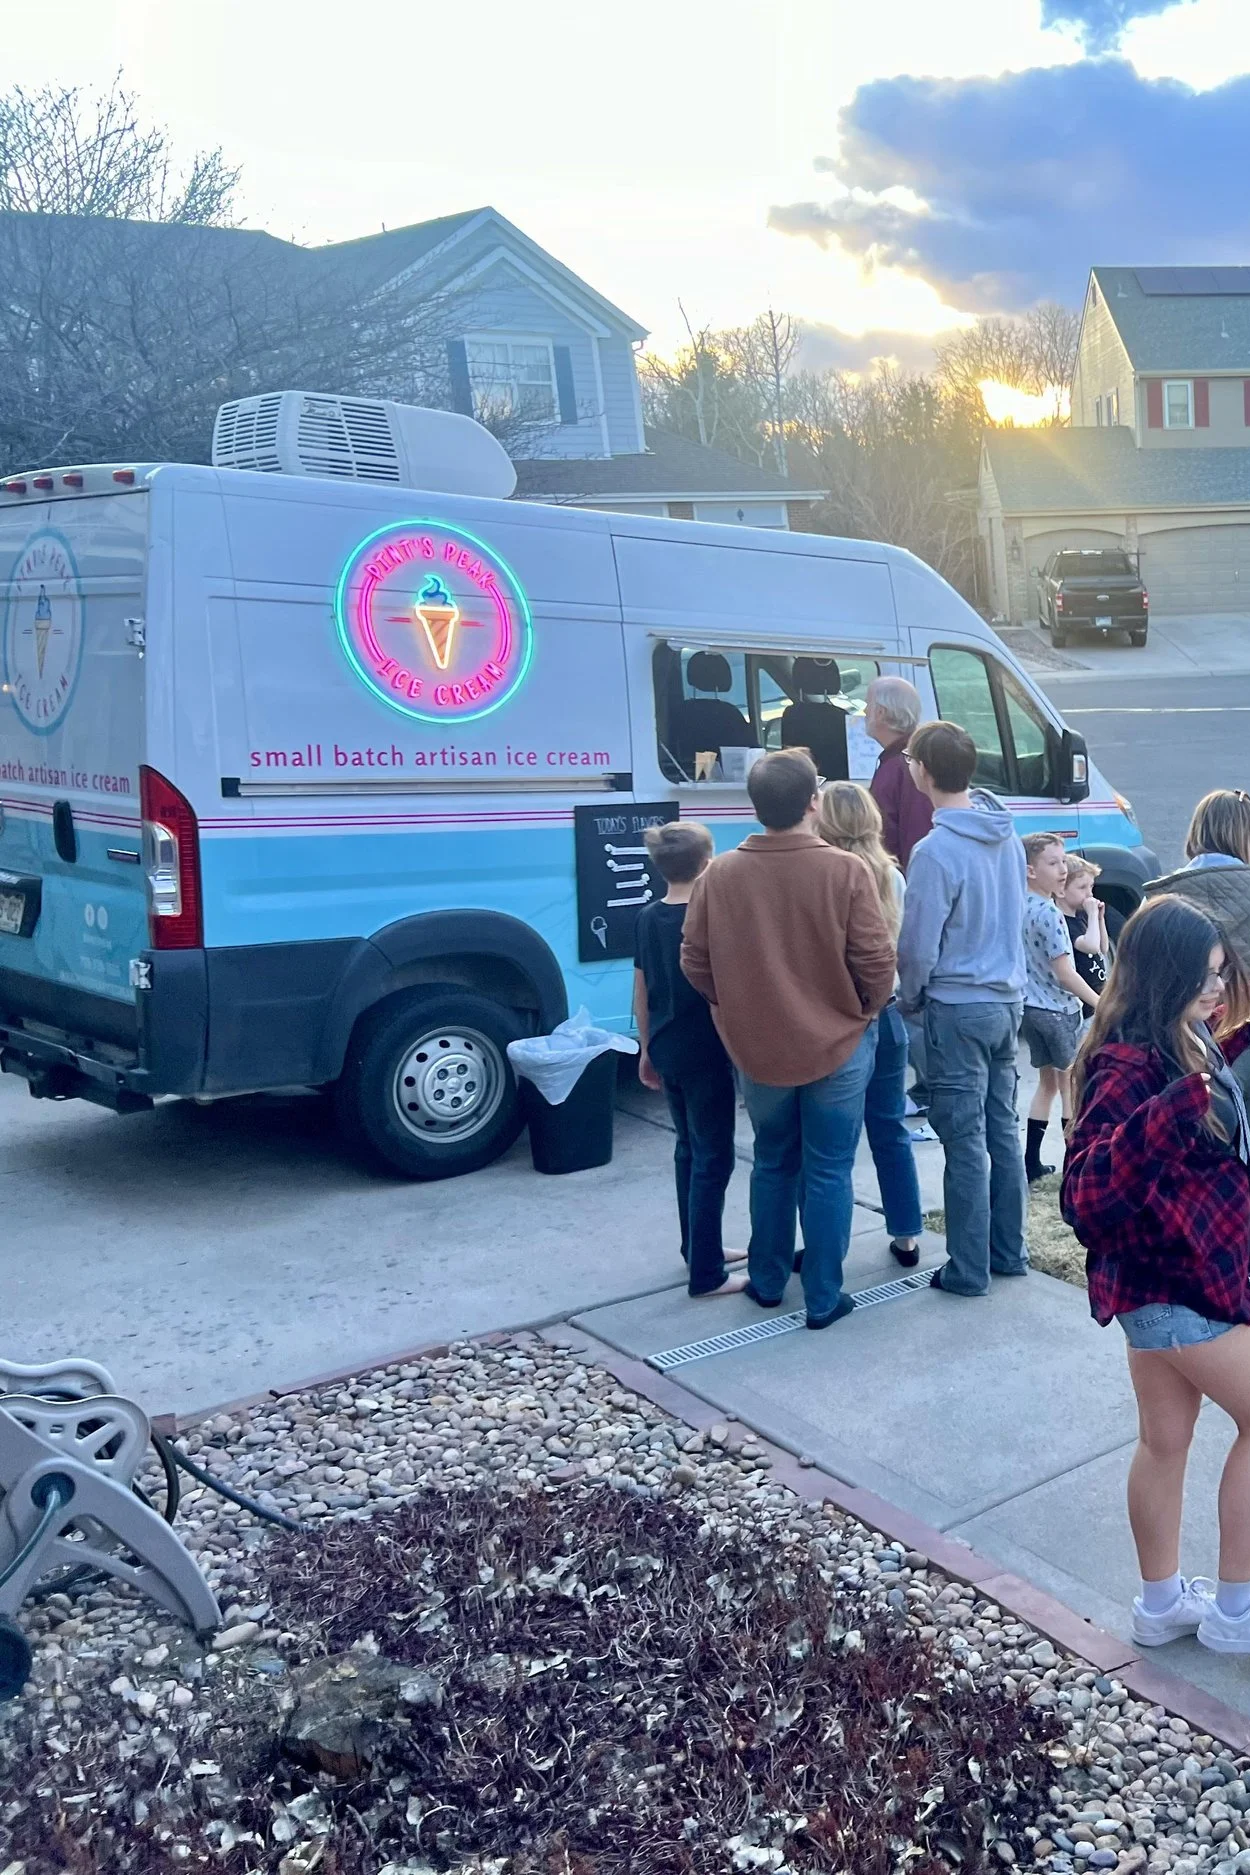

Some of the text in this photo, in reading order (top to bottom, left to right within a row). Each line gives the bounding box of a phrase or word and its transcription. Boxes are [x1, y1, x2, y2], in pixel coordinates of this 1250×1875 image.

[445, 542, 494, 589] PEAK
[14, 673, 69, 718] ICE CREAM
[376, 658, 505, 705] ICE CREAM
[0, 758, 130, 793] atch artisan ice cream
[250, 744, 611, 767] small batch artisan ice cream
